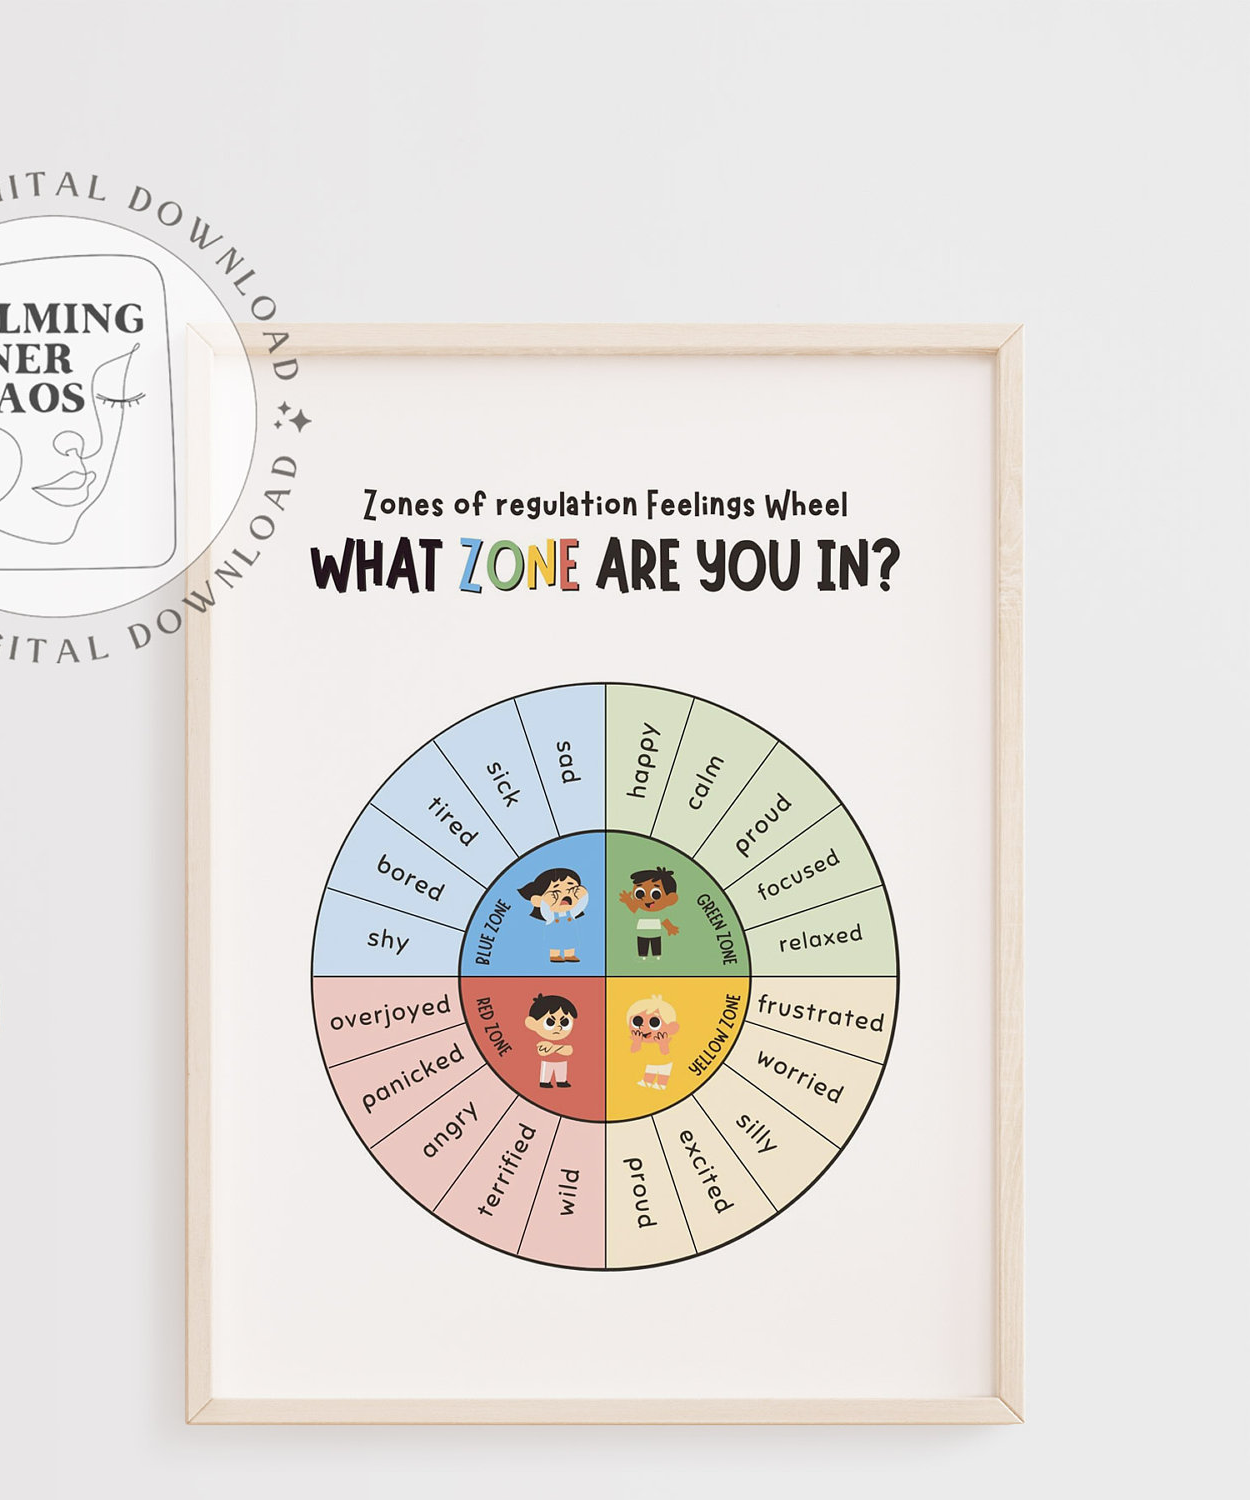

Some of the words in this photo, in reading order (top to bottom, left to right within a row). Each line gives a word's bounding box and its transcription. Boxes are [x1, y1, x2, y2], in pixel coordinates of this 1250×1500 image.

[362, 488, 444, 522] Zones
[453, 489, 487, 517] of
[496, 490, 638, 521] regulation
[646, 488, 756, 521] Feelings
[764, 488, 848, 522] Wheel
[309, 535, 444, 595] WHAT
[458, 537, 581, 595] ZONE
[595, 535, 681, 595] ARE
[696, 538, 801, 593] YOU
[816, 536, 901, 593] IN?
[486, 761, 521, 808] sick
[556, 740, 582, 785] sad
[625, 721, 662, 799] happy
[688, 755, 725, 810] calm
[427, 796, 480, 848] tired
[735, 792, 793, 859] proud
[377, 853, 446, 902] bored
[757, 847, 841, 901] focused
[483, 898, 512, 934] ZONE
[696, 893, 728, 931] GREEN
[716, 930, 738, 966] ZONE
[779, 922, 863, 953] relaxed
[366, 928, 410, 956] shy
[475, 932, 496, 966] BLUE
[330, 993, 451, 1031] overjoyed
[476, 996, 495, 1021] RED
[757, 993, 885, 1033] frustrated
[484, 1022, 513, 1058] ZONE
[687, 1027, 730, 1077] YELLOW
[718, 993, 742, 1030] ZONE
[362, 1042, 465, 1115] panicked
[757, 1050, 845, 1104] worried
[423, 1100, 478, 1158] angry
[735, 1114, 778, 1154] silly
[477, 1122, 537, 1217] terrified
[557, 1168, 580, 1216] wild
[622, 1157, 658, 1229] proud
[679, 1129, 735, 1215] excited
